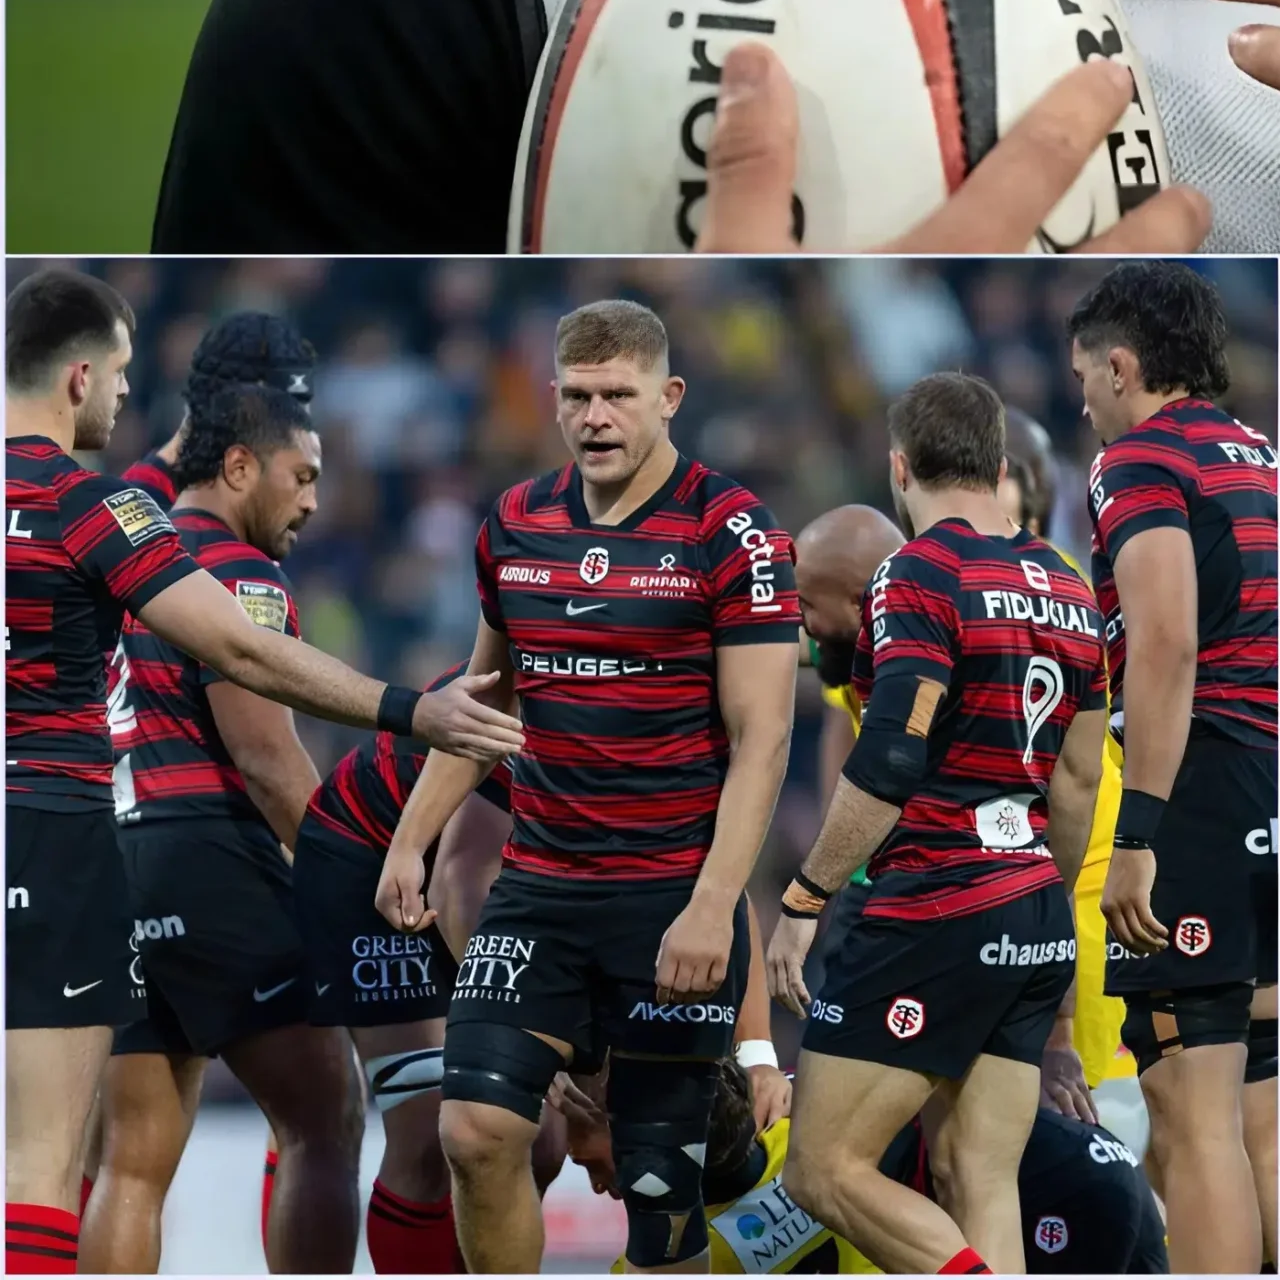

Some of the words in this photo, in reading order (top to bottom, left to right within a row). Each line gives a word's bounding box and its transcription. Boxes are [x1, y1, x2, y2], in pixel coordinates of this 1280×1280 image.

[726, 512, 782, 613] actual
[521, 653, 664, 677] PEUGE
[353, 935, 433, 958] GREEN
[465, 935, 537, 962] GREEN
[353, 956, 432, 989] CITY
[455, 957, 530, 990] CITY
